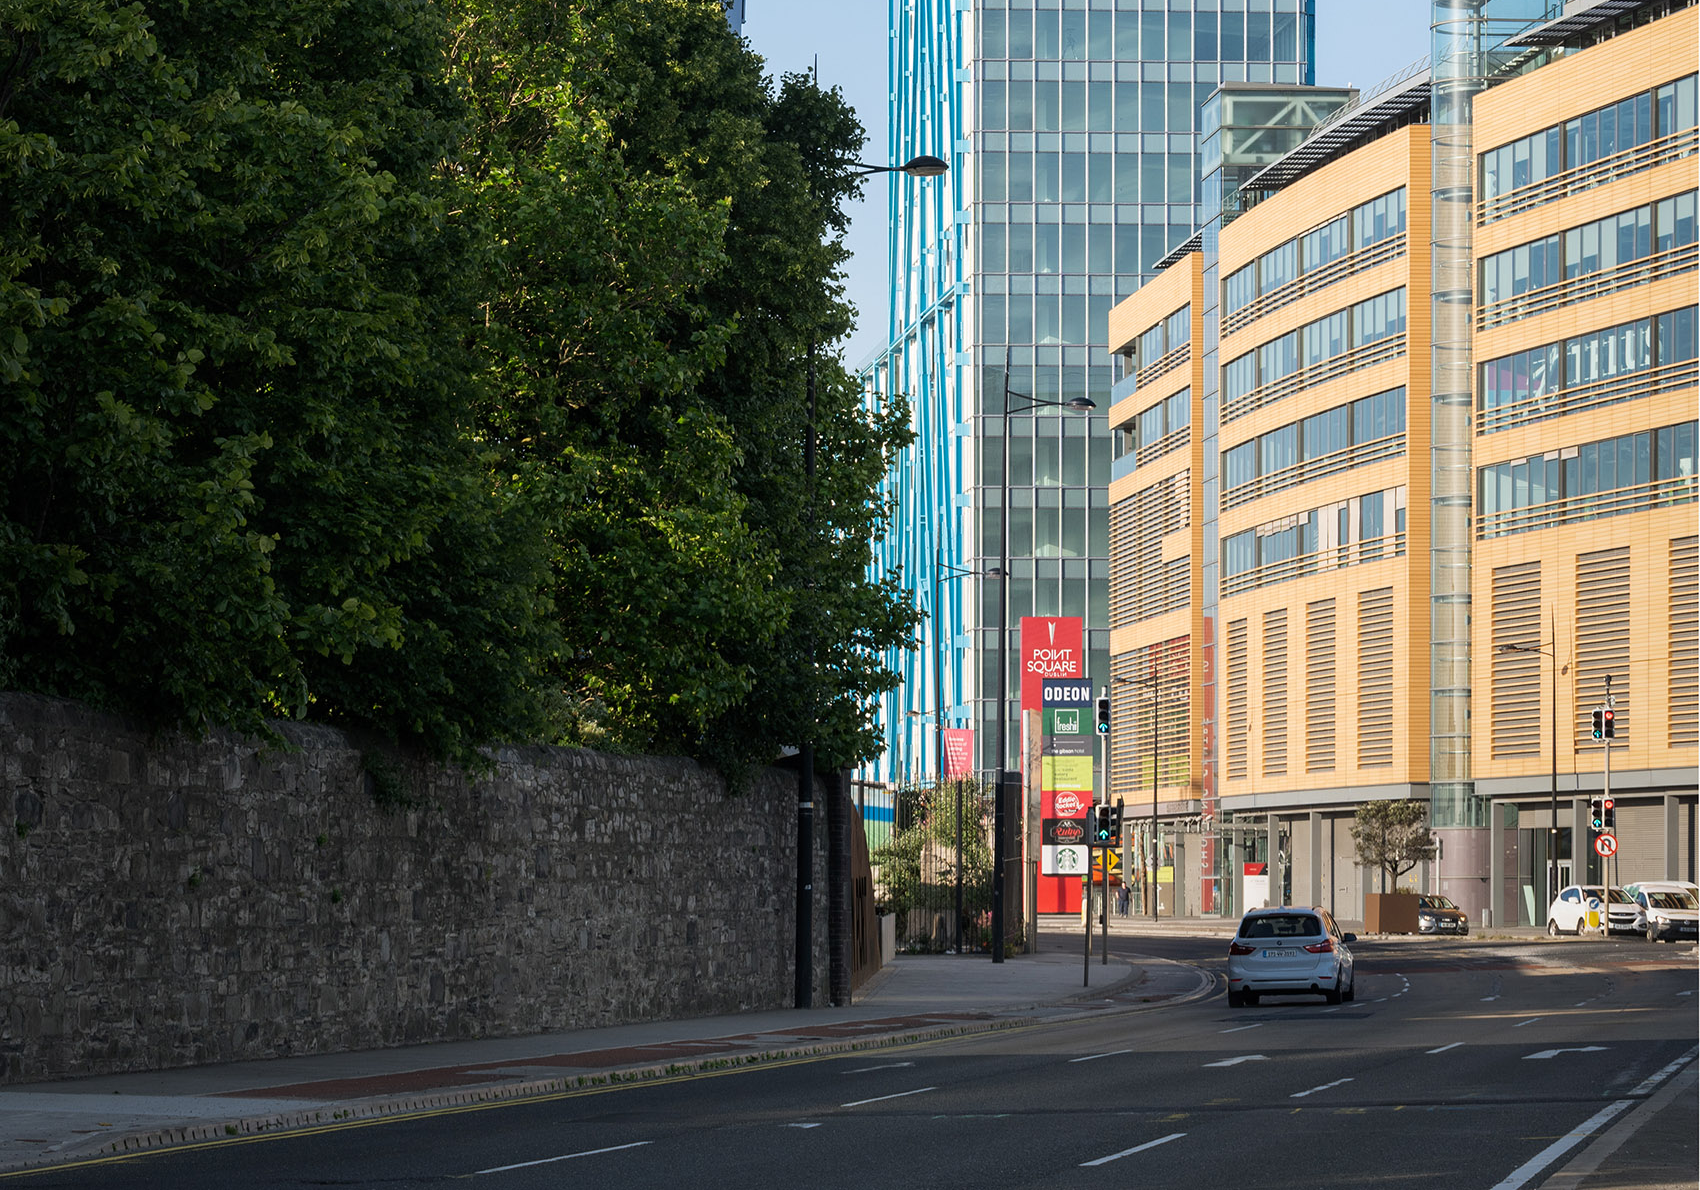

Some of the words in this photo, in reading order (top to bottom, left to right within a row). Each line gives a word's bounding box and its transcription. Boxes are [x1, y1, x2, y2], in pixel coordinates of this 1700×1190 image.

[1033, 649, 1072, 661] POINT
[1027, 661, 1077, 674] SQUARE
[1044, 686, 1090, 701] ODEON
